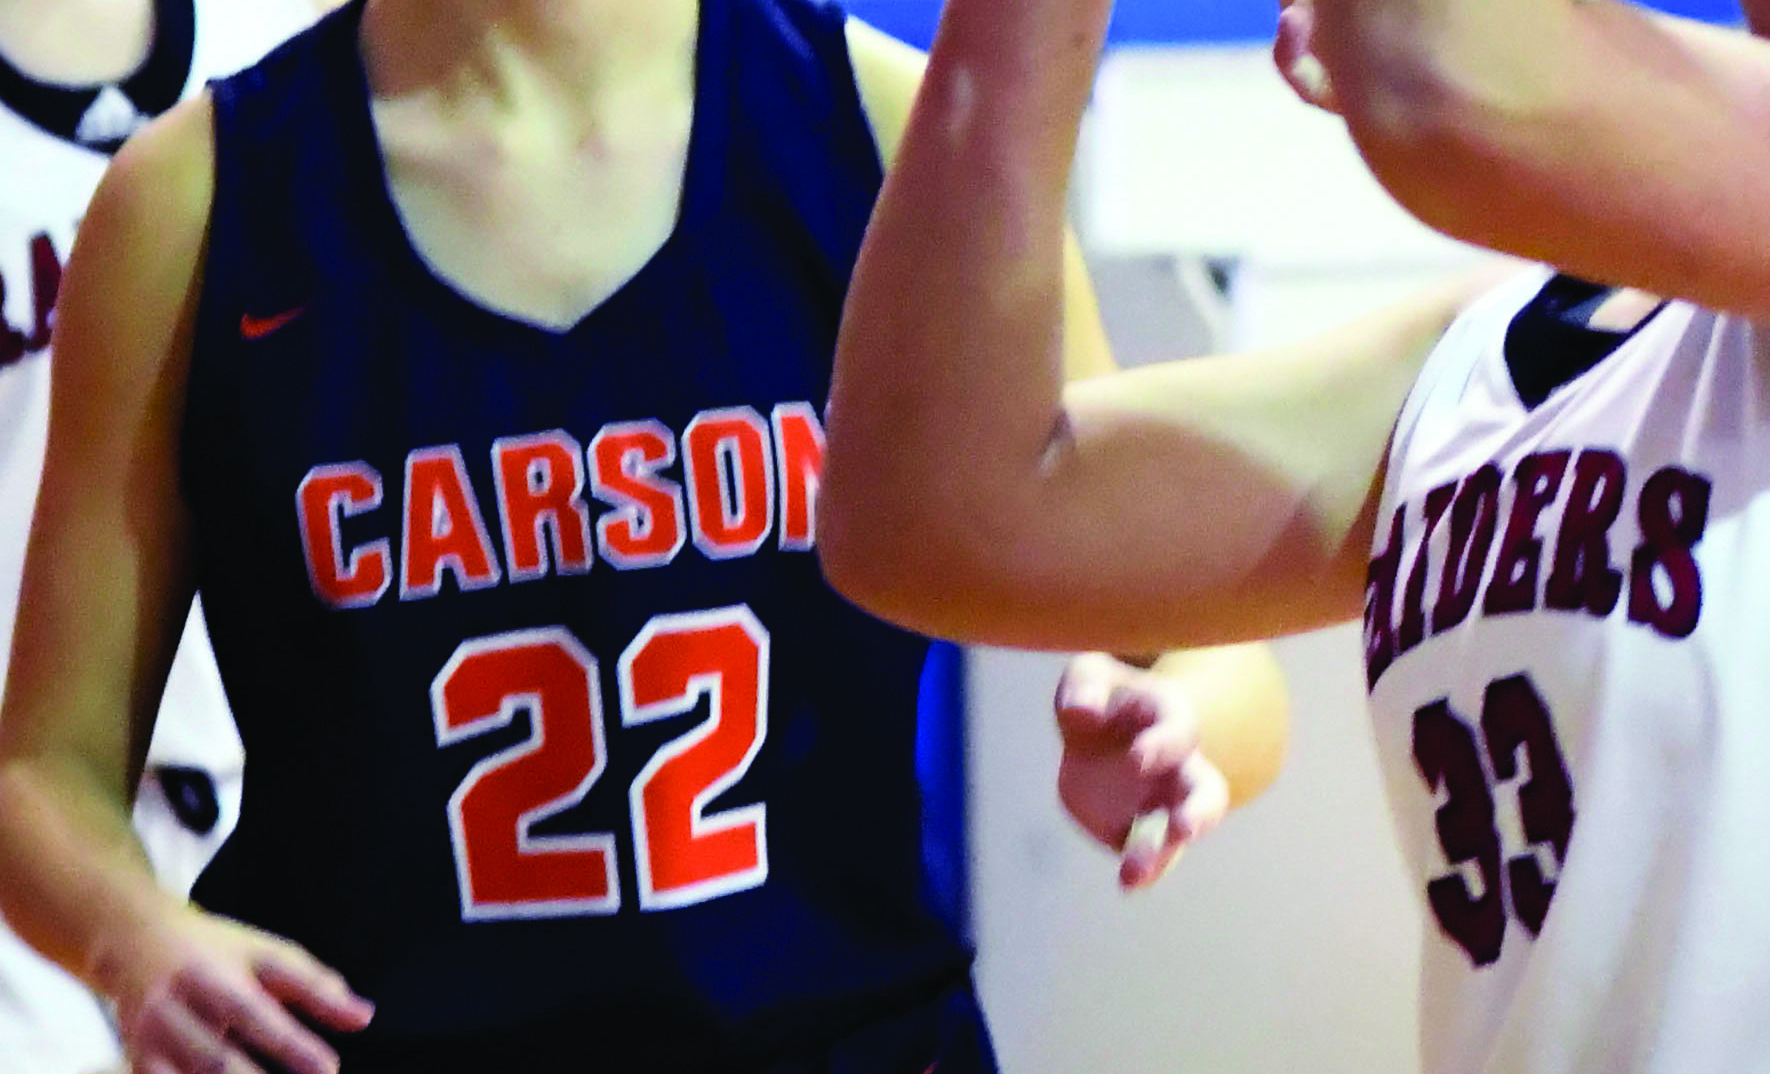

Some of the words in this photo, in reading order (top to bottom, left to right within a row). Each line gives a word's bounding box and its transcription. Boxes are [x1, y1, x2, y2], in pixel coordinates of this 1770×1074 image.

[1363, 448, 1712, 695] AIDERS
[429, 602, 771, 923] 22
[1411, 670, 1577, 969] 33
